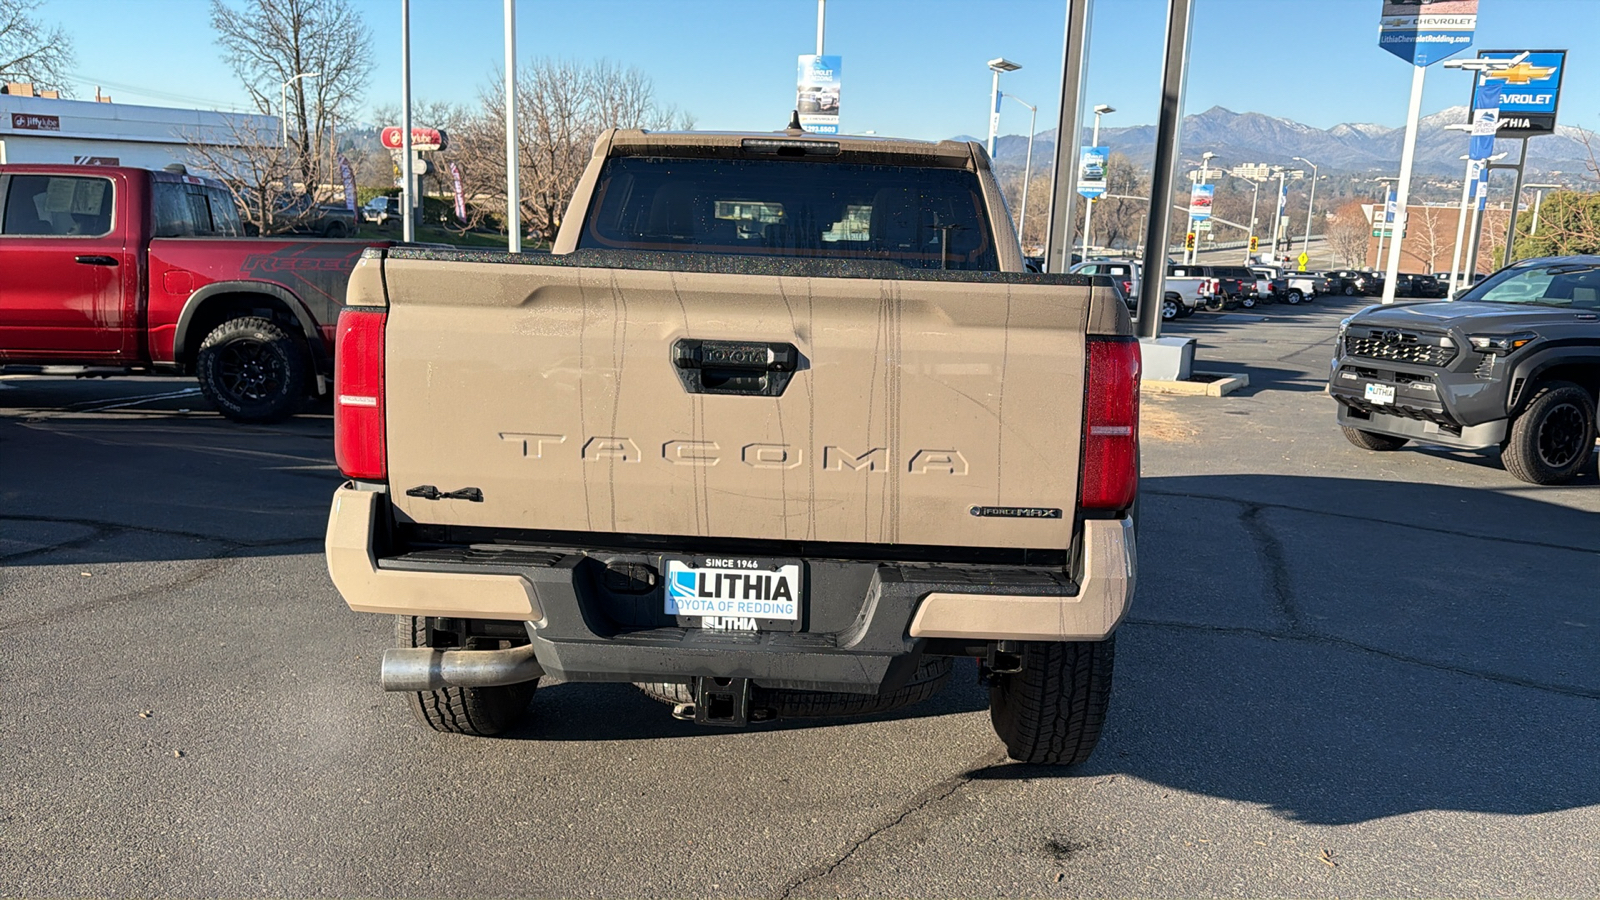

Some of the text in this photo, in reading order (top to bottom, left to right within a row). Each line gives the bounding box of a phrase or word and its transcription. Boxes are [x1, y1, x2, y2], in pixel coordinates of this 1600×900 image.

[1381, 35, 1470, 44] LithiaChevroletRedding.com
[1499, 94, 1552, 104] EVROLET
[706, 349, 766, 362] TOYOTA
[1372, 387, 1393, 397] LITHIA
[498, 432, 969, 476] TACOMA
[705, 558, 759, 569] SINCE 1946
[698, 572, 793, 602] LITHIA
[669, 599, 794, 614] TOYOTA OF REDDING
[714, 617, 758, 631] LITHIA
